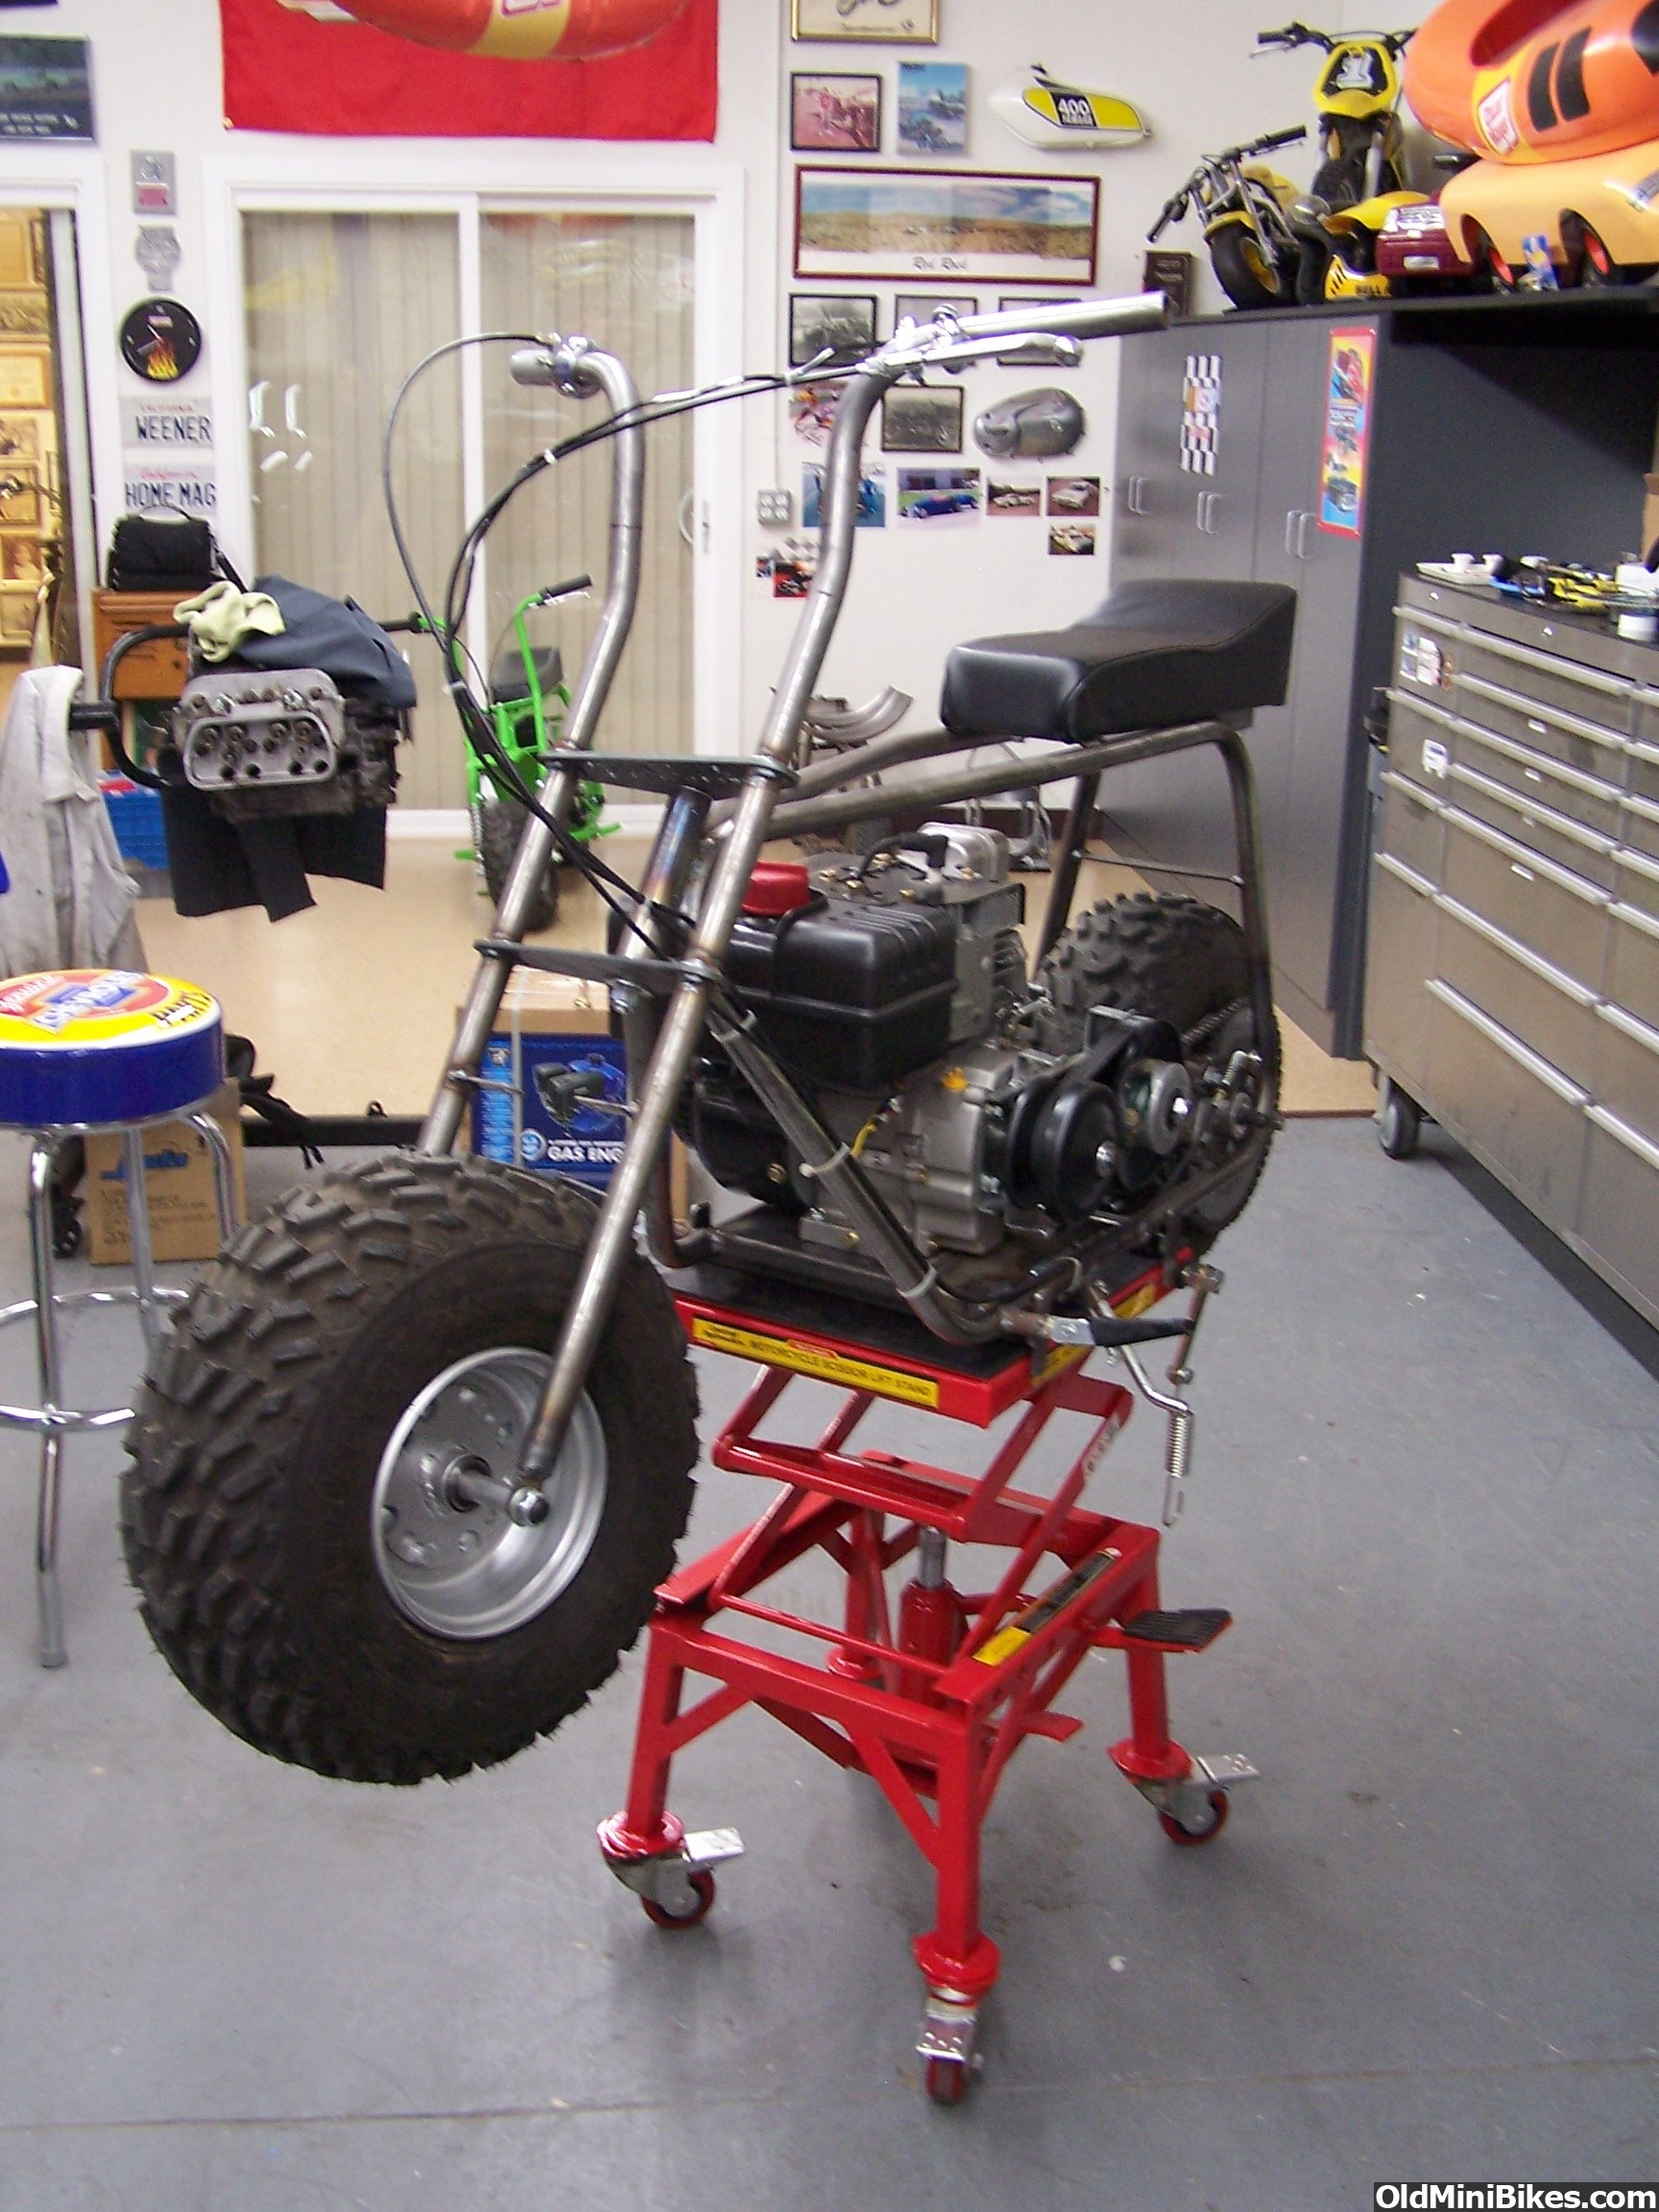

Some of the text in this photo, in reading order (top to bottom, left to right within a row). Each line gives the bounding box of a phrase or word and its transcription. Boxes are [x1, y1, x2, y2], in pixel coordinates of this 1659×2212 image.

[1058, 98, 1090, 115] 400
[135, 415, 210, 441] WEENER
[125, 482, 216, 507] HOME MAG
[547, 1146, 586, 1163] GAS
